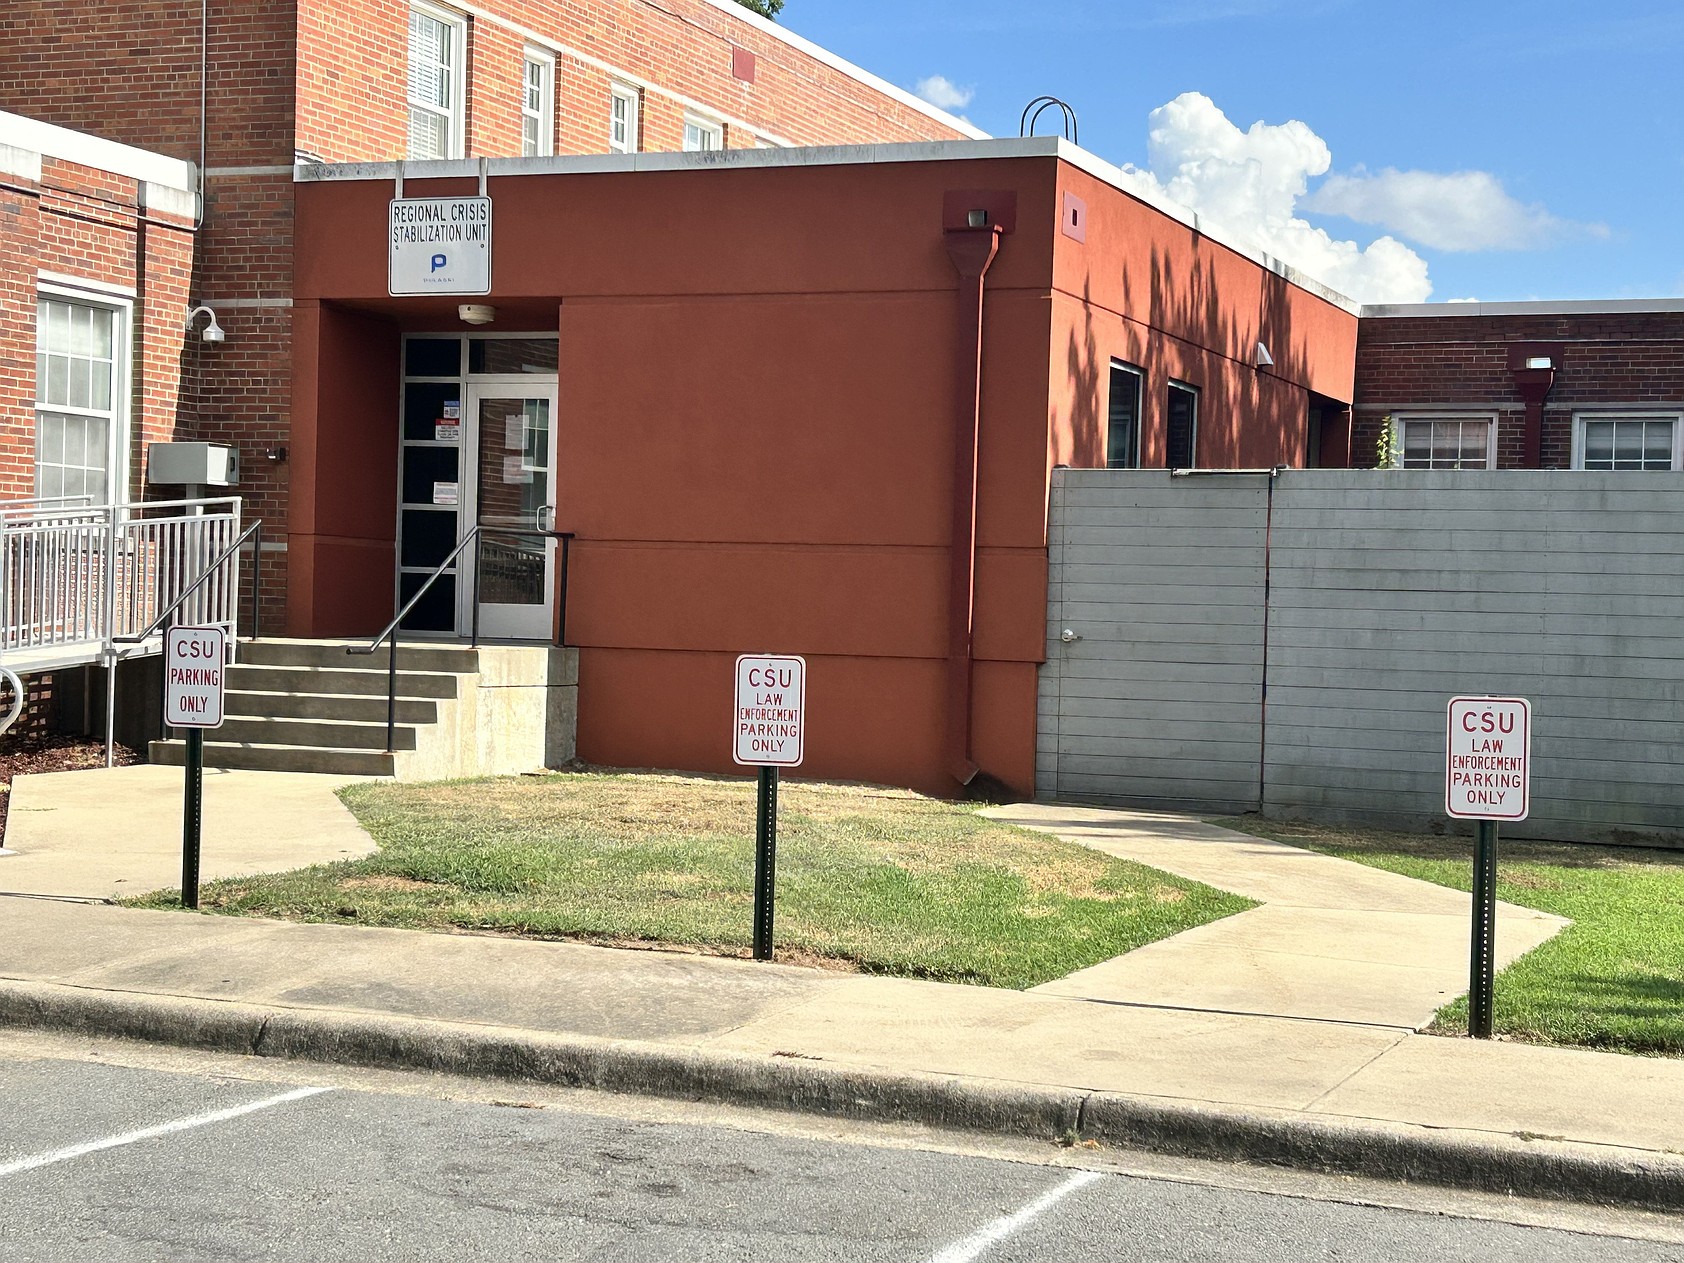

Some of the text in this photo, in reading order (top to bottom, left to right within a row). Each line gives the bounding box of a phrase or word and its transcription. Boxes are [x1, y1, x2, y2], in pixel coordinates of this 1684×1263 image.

[394, 203, 486, 223] REGIONAL CRISIS
[394, 223, 486, 243] STABILIZATION UNIT
[177, 640, 213, 658] CSU
[171, 668, 218, 686] PARKING
[749, 668, 792, 688] CSU
[180, 696, 208, 713] ONLY
[756, 693, 783, 705] LAW
[740, 708, 797, 722] ENFORCEMENT
[1462, 711, 1514, 733] CSU
[740, 723, 797, 737] PARKING
[752, 739, 785, 752] ONLY
[1472, 739, 1503, 753] LAW
[1452, 755, 1522, 771] ENFORCEMENT
[1453, 773, 1521, 788] PARKING
[1467, 790, 1506, 805] ONLY
